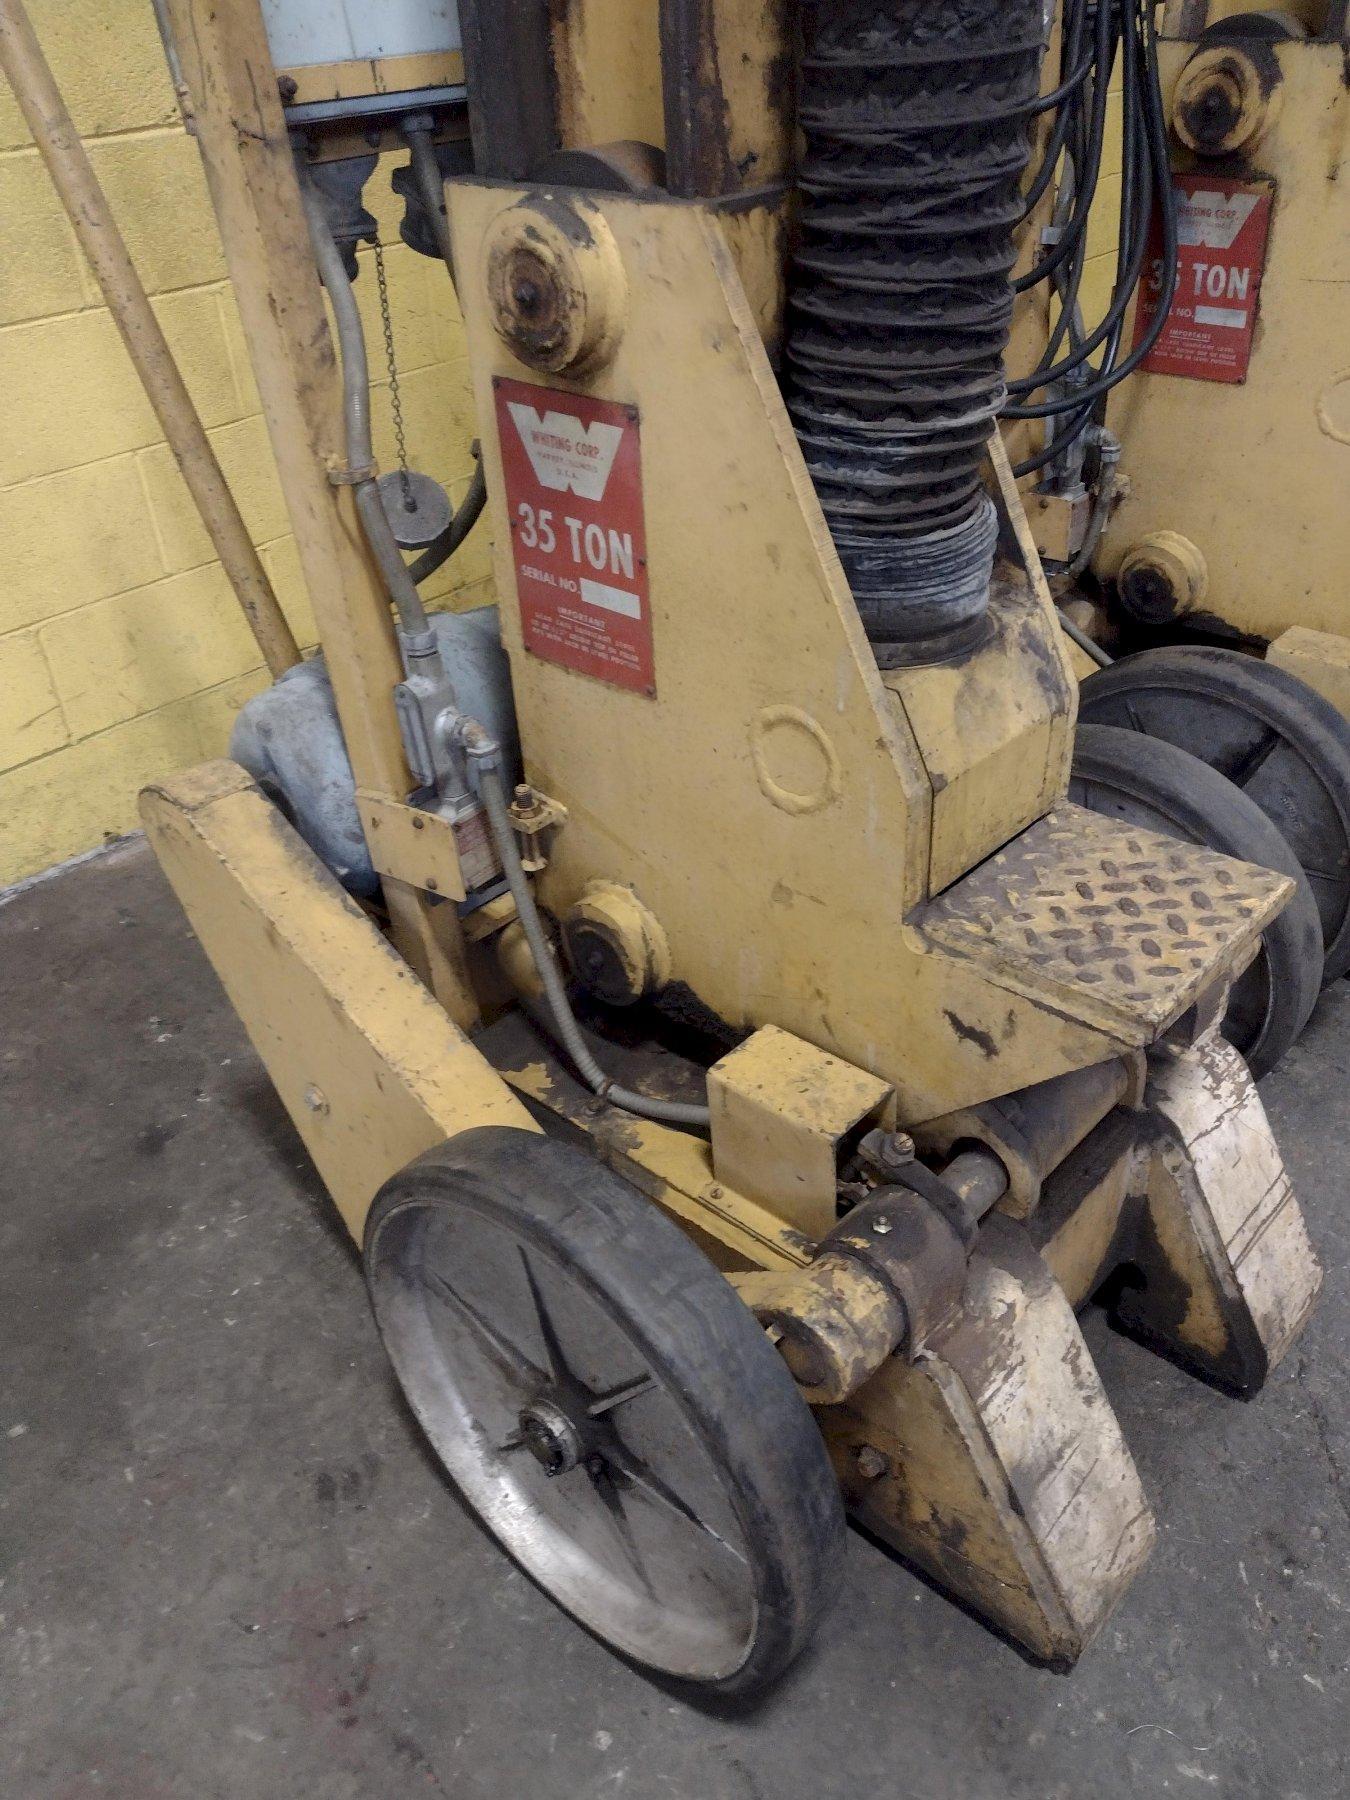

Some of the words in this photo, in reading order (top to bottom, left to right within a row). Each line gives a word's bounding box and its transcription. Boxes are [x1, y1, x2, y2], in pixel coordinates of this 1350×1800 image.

[1192, 262, 1250, 300] TON
[518, 502, 556, 553] 35
[564, 516, 634, 580] TON
[520, 564, 558, 587] SERIAL
[559, 576, 581, 594] NO.
